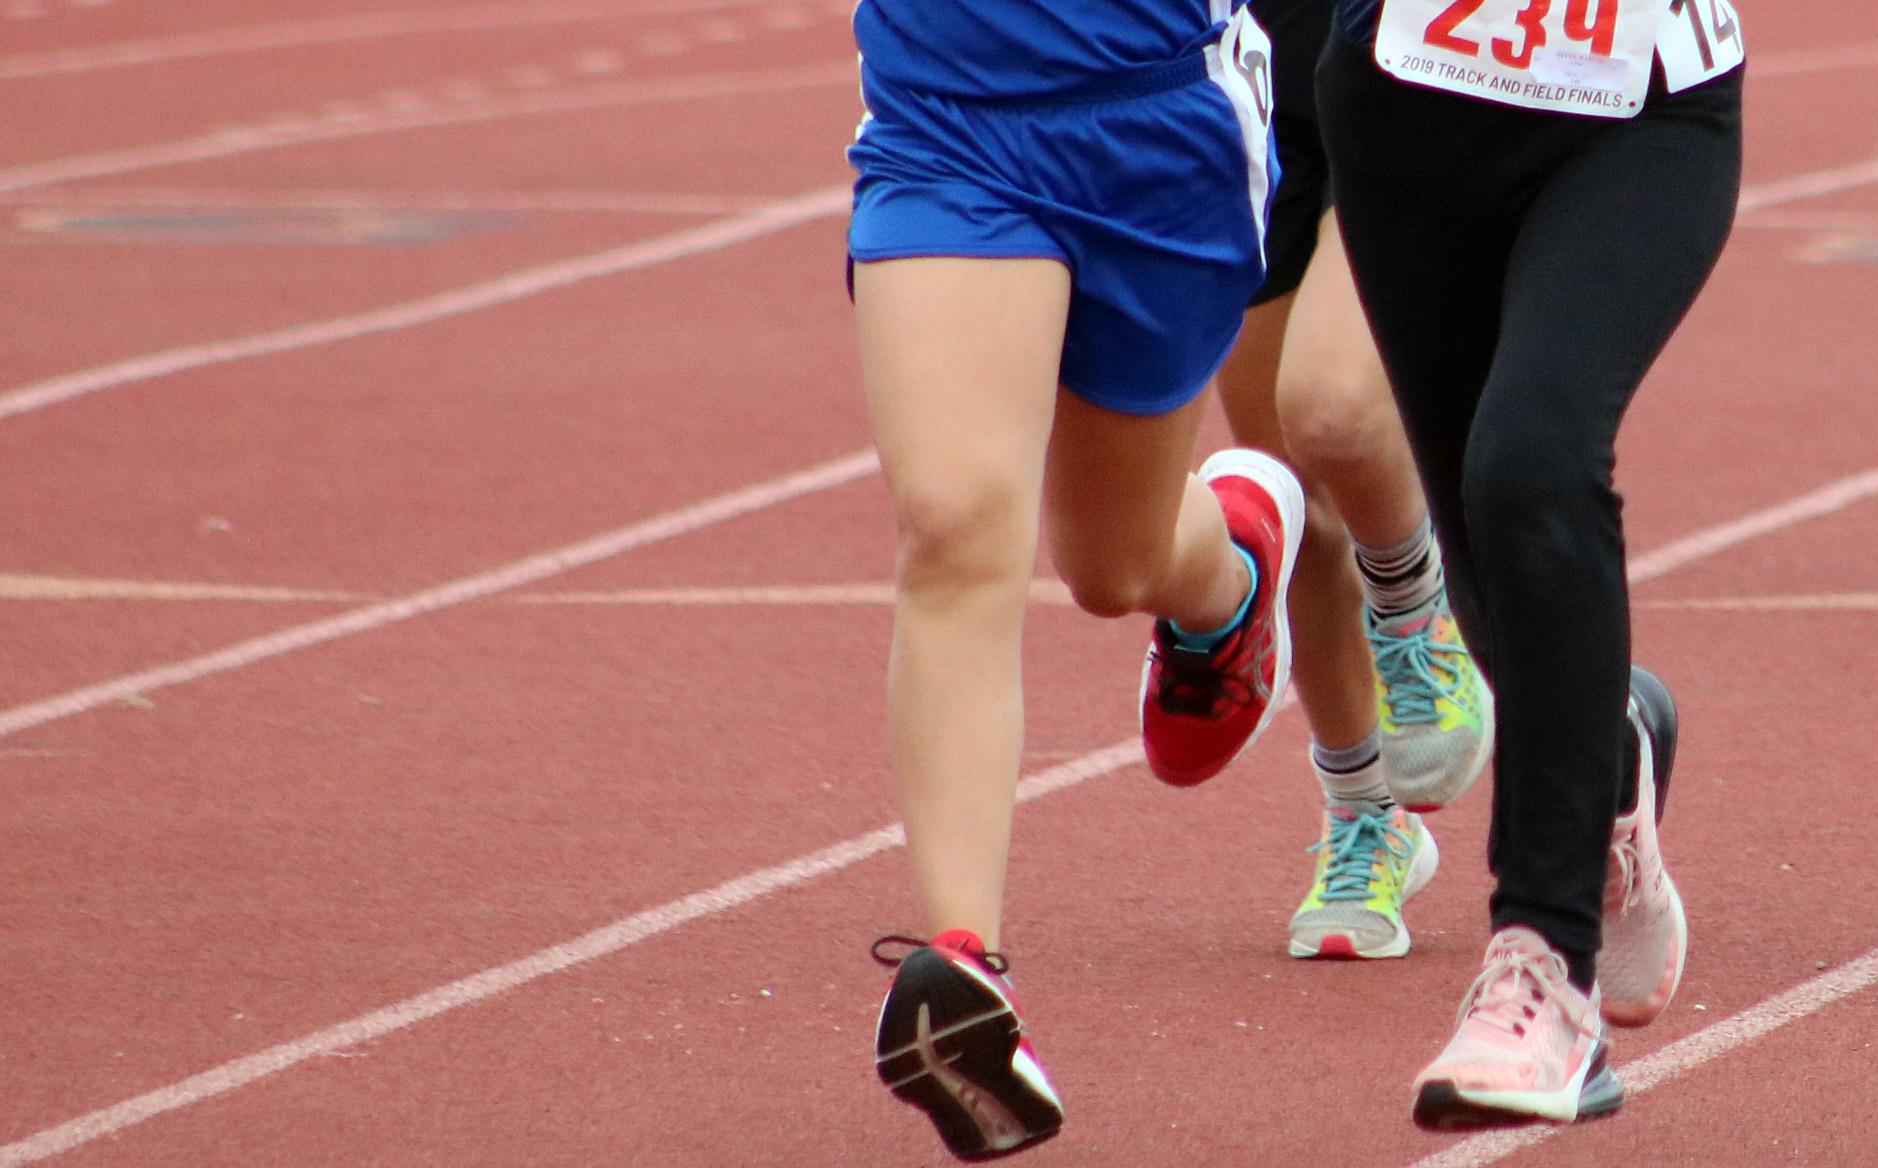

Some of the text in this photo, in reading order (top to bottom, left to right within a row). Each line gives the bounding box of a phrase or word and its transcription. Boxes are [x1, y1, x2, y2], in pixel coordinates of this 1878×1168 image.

[1401, 54, 1623, 108] 2019 TRACK AND FIELD FINALS
